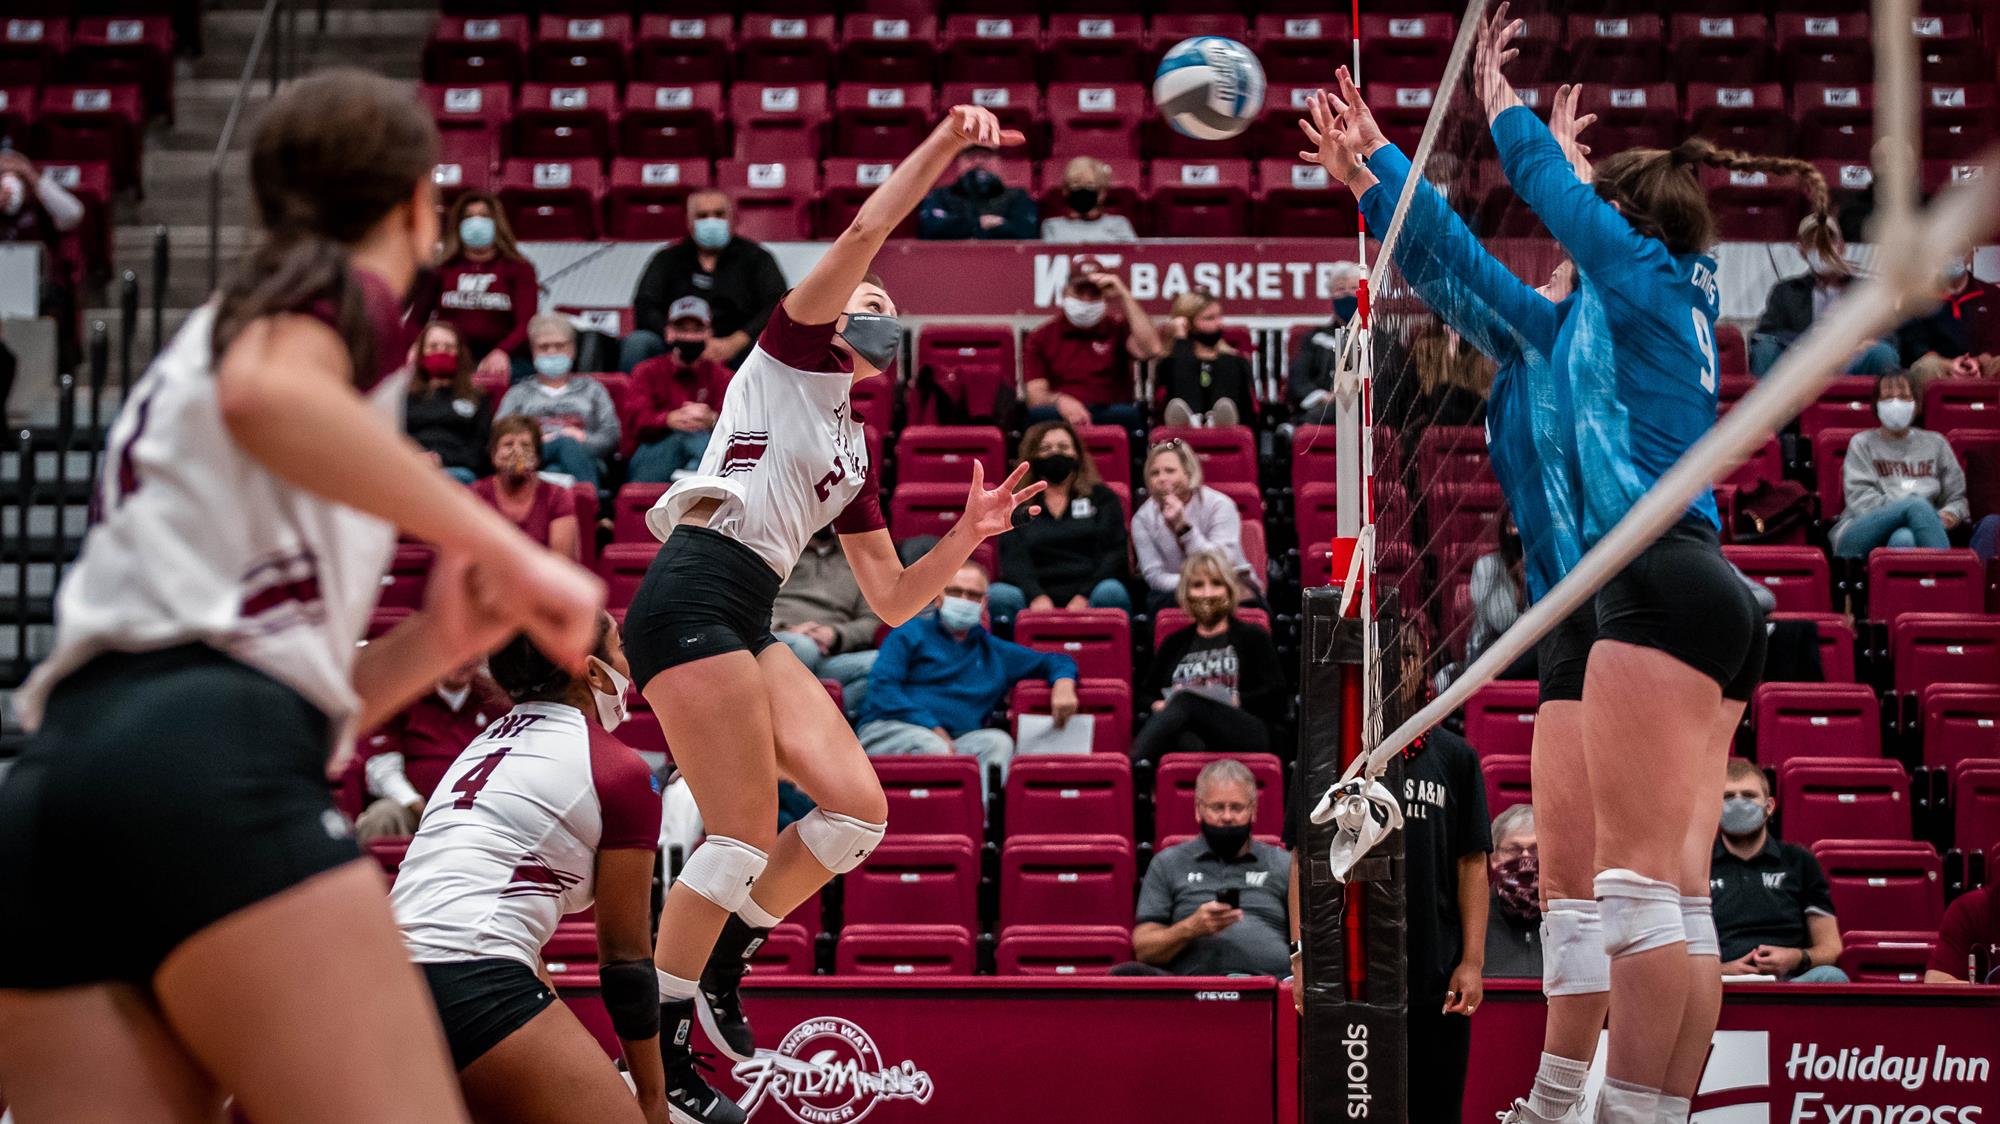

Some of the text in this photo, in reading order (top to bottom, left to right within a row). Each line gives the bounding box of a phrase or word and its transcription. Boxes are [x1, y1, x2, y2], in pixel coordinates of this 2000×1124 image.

[1691, 306, 1715, 394] 9
[814, 455, 846, 503] 2
[487, 713, 547, 739] WT
[450, 747, 513, 810] 4
[1417, 779, 1446, 808] A&M
[1761, 871, 1786, 889] WT
[783, 1020, 872, 1055] WRONG WAY
[1341, 1023, 1372, 1119] sports
[1785, 1042, 1990, 1090] Holiday Inn
[800, 1104, 856, 1123] DINER
